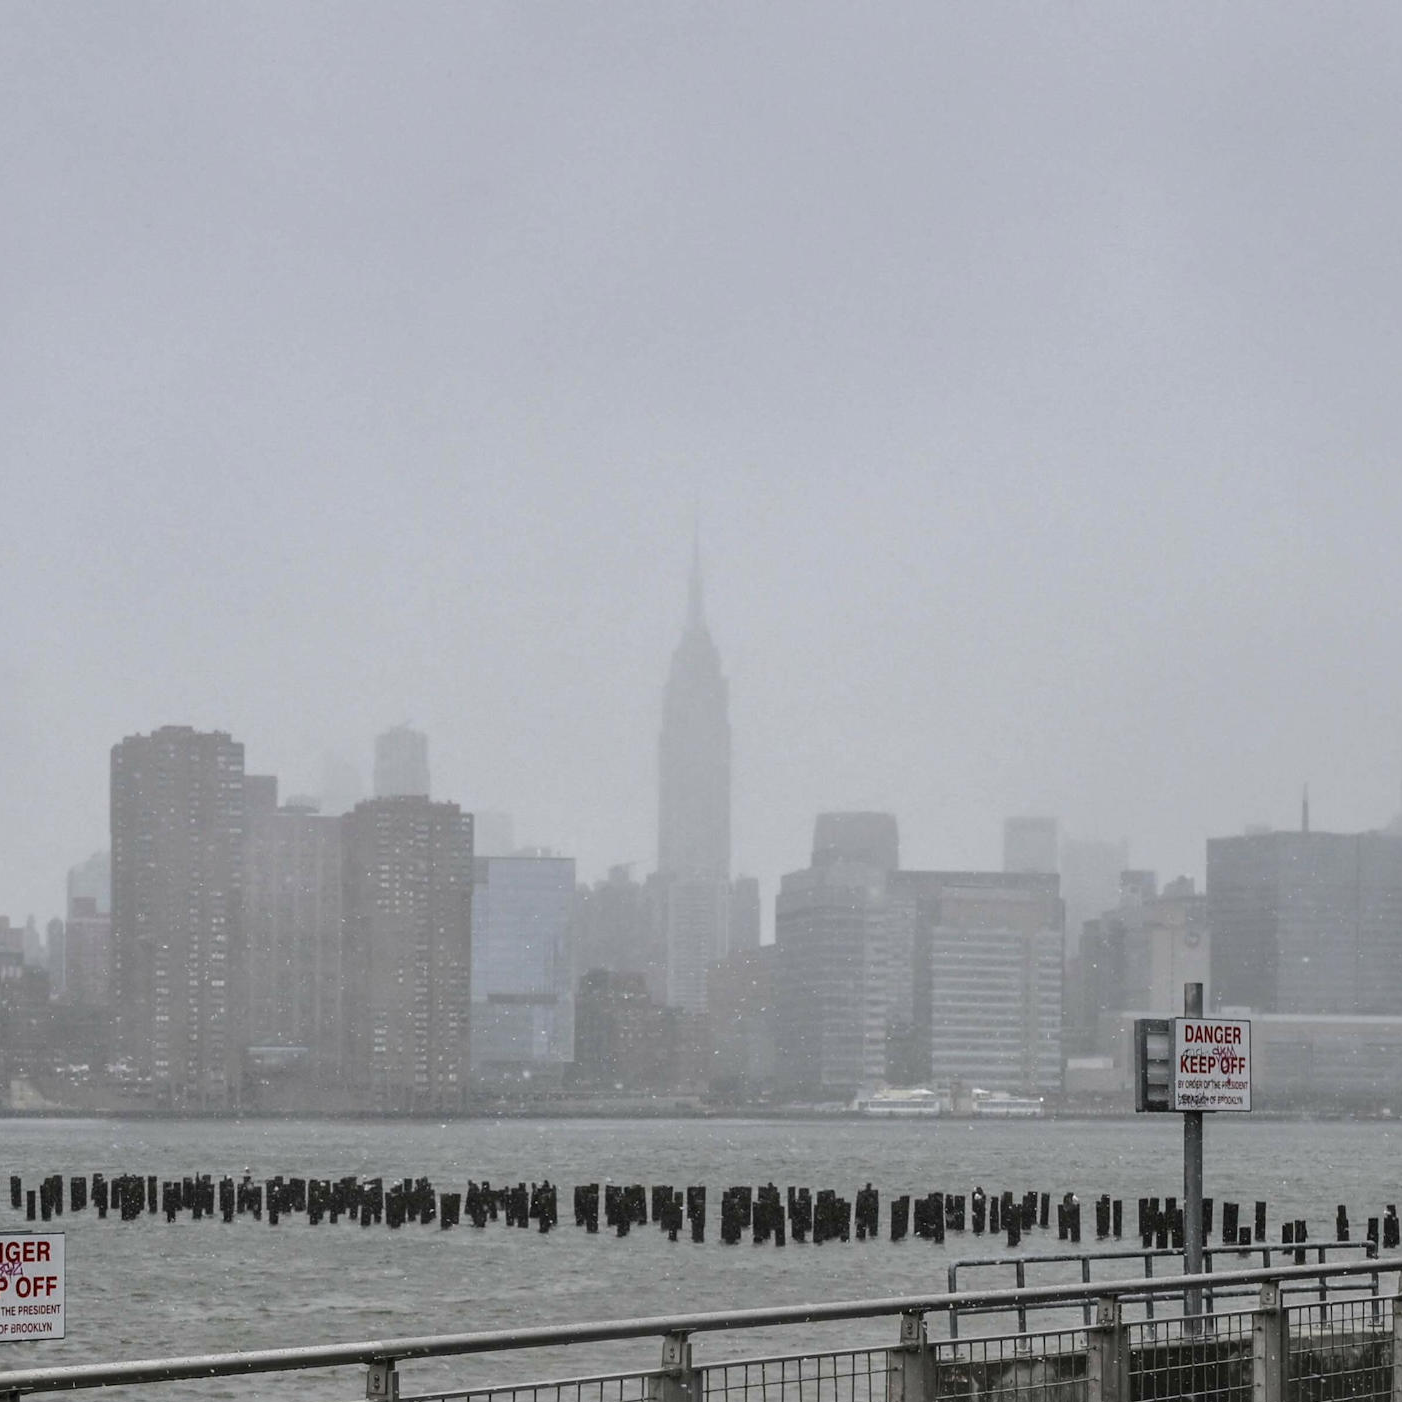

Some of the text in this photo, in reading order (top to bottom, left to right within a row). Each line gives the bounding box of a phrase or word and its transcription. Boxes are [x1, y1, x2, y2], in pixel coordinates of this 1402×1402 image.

[1185, 1025, 1241, 1045] DANGER
[1180, 1056, 1246, 1075] KEEP OFF
[1178, 1080, 1184, 1089] BY
[1185, 1080, 1203, 1090] ORDER
[1203, 1080, 1211, 1089] OF
[1209, 1096, 1217, 1105] OF
[1217, 1096, 1243, 1105] BROOKLYN
[15, 1276, 58, 1298] OFF
[1, 1305, 16, 1316] THE
[18, 1303, 61, 1316] PRESIDENT
[10, 1322, 53, 1334] BROOKLYN
